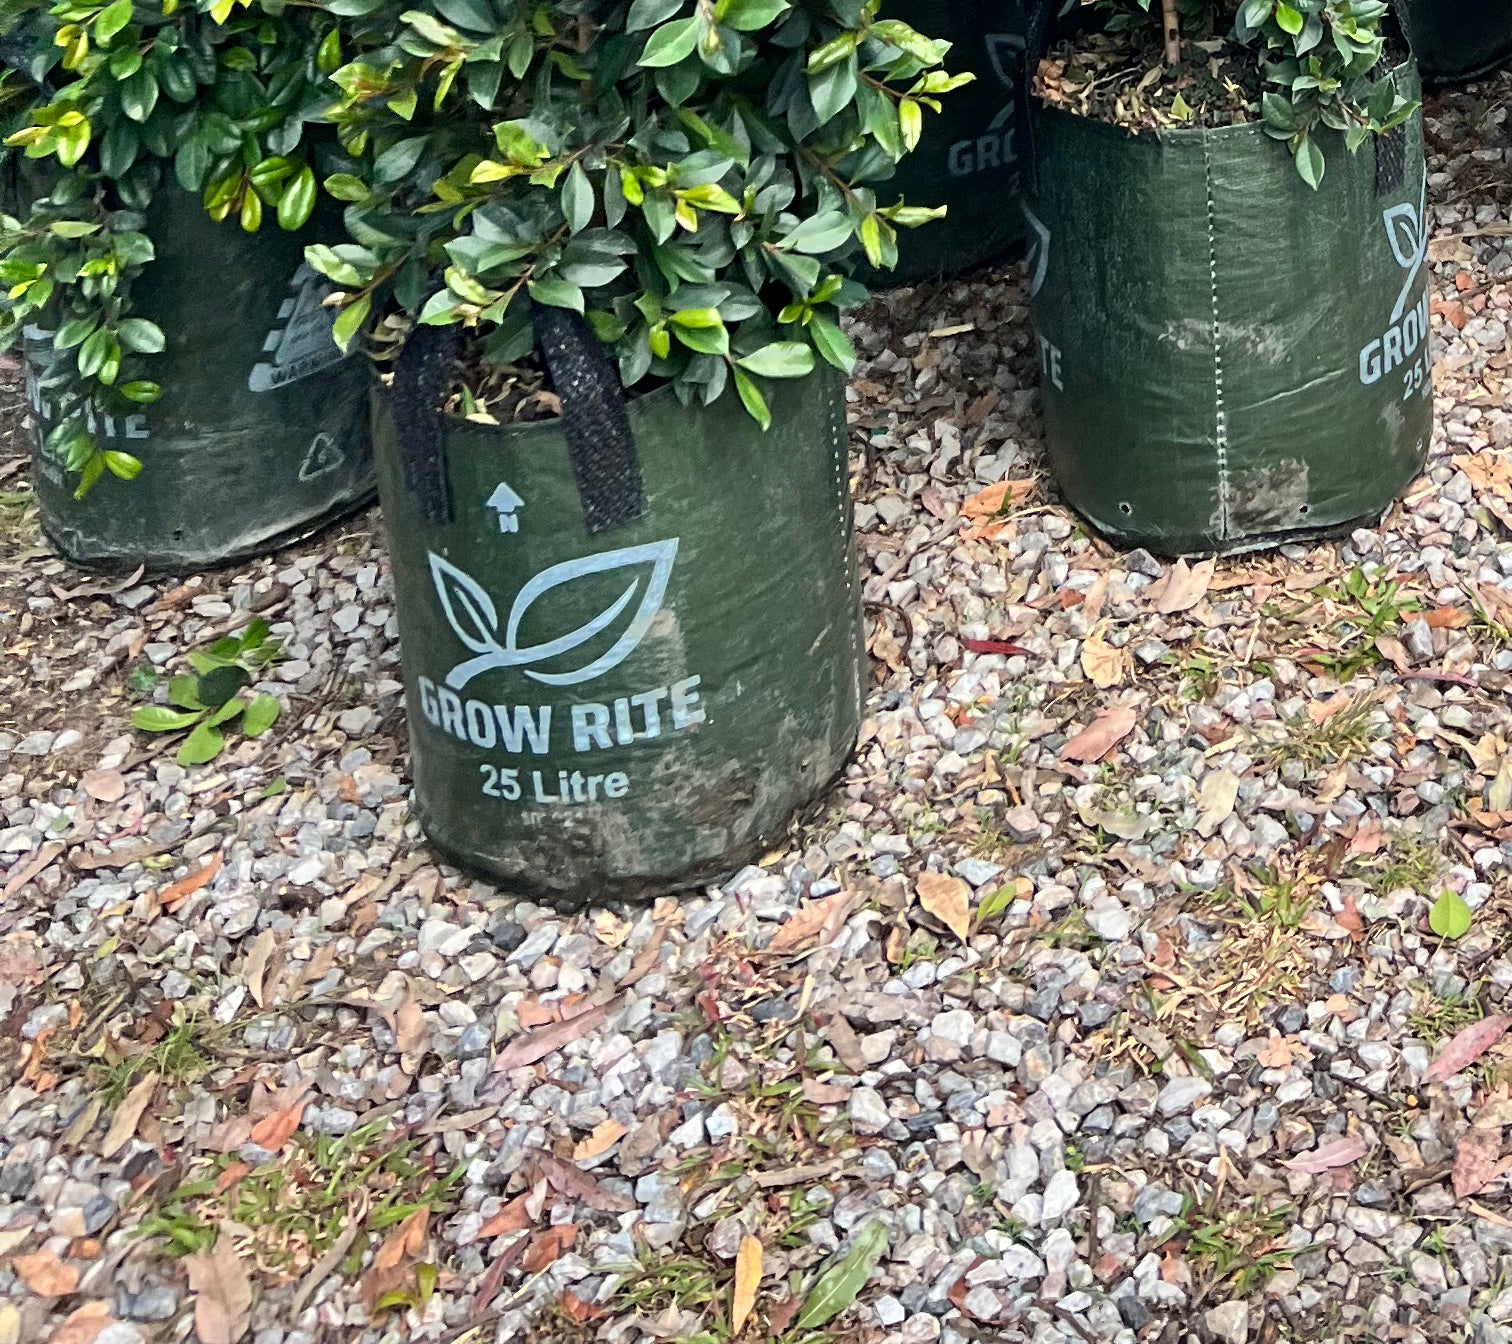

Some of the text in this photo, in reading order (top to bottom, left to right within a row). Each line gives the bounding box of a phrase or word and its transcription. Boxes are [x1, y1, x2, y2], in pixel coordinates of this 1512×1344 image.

[947, 127, 1018, 177] GR
[1403, 358, 1423, 401] 25
[418, 674, 706, 754] GROW RITE
[479, 764, 630, 804] 25 Litre
